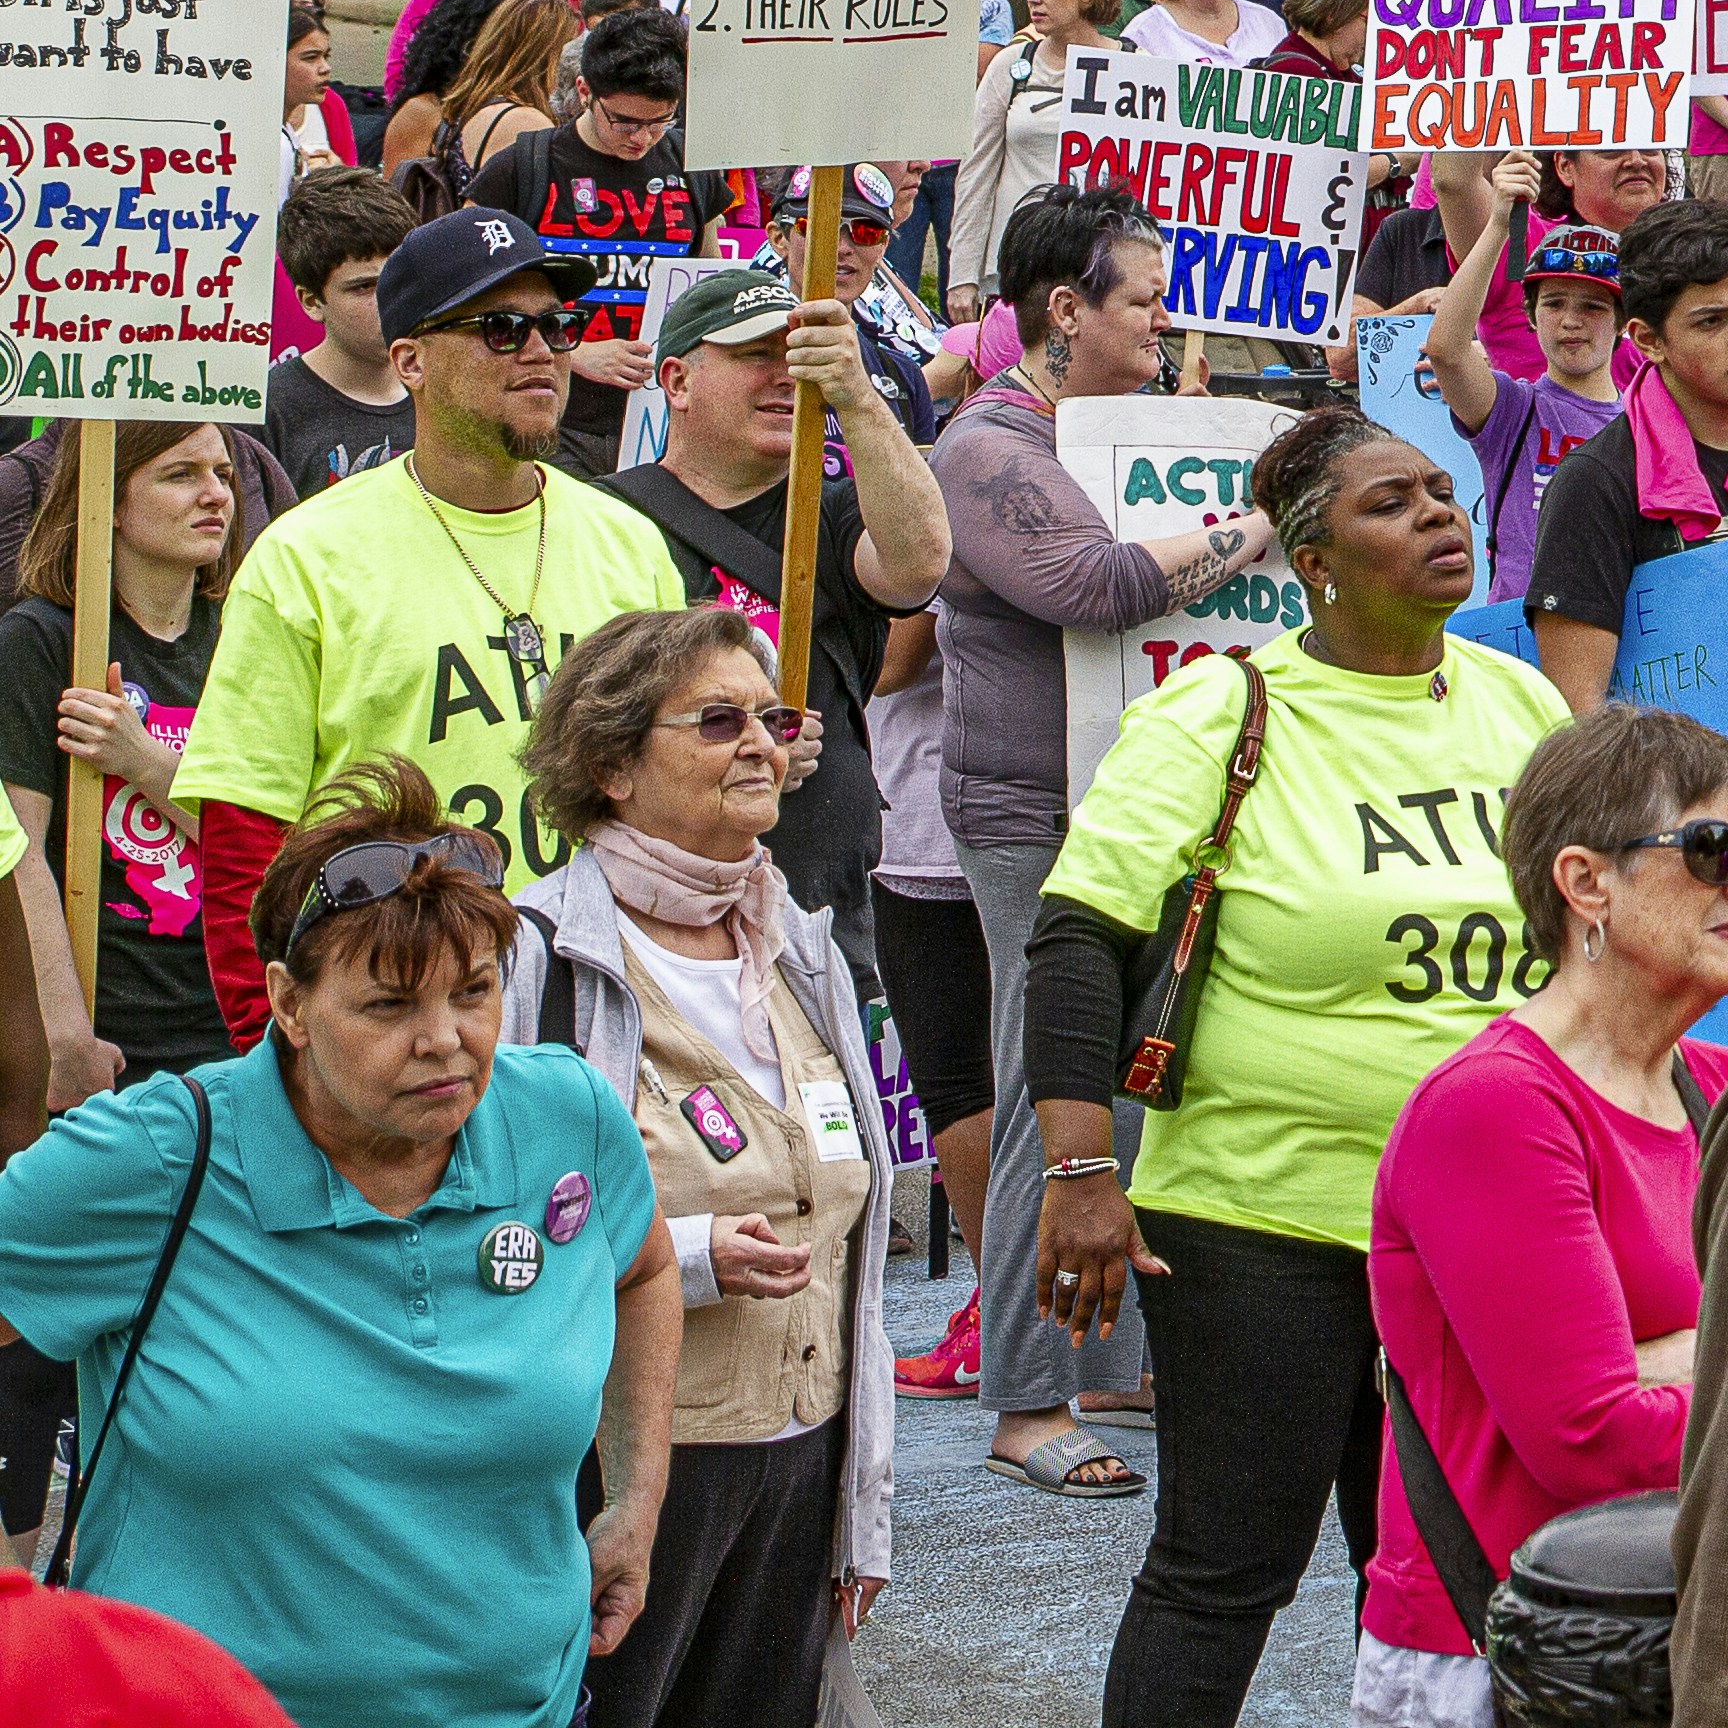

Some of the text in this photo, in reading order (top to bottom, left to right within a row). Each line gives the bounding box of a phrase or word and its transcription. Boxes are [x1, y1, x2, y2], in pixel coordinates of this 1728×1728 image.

[100, 15, 142, 74] to
[155, 27, 253, 80] have
[1375, 22, 1667, 81] DON'T FEAR
[1071, 57, 1109, 115] I
[1114, 80, 1167, 122] am
[1371, 71, 1684, 149] EQUALITY
[43, 122, 237, 195] Respect
[1060, 130, 1301, 238] POWERFUL
[35, 181, 260, 254] Pay Equity
[538, 181, 692, 242] LOVE
[25, 239, 242, 299] Control of
[10, 294, 272, 346] their own bodies
[18, 351, 262, 410] All of the above
[114, 834, 182, 864] 4-25-2017
[489, 1258, 538, 1288] YES
[493, 1225, 537, 1261] ERA
